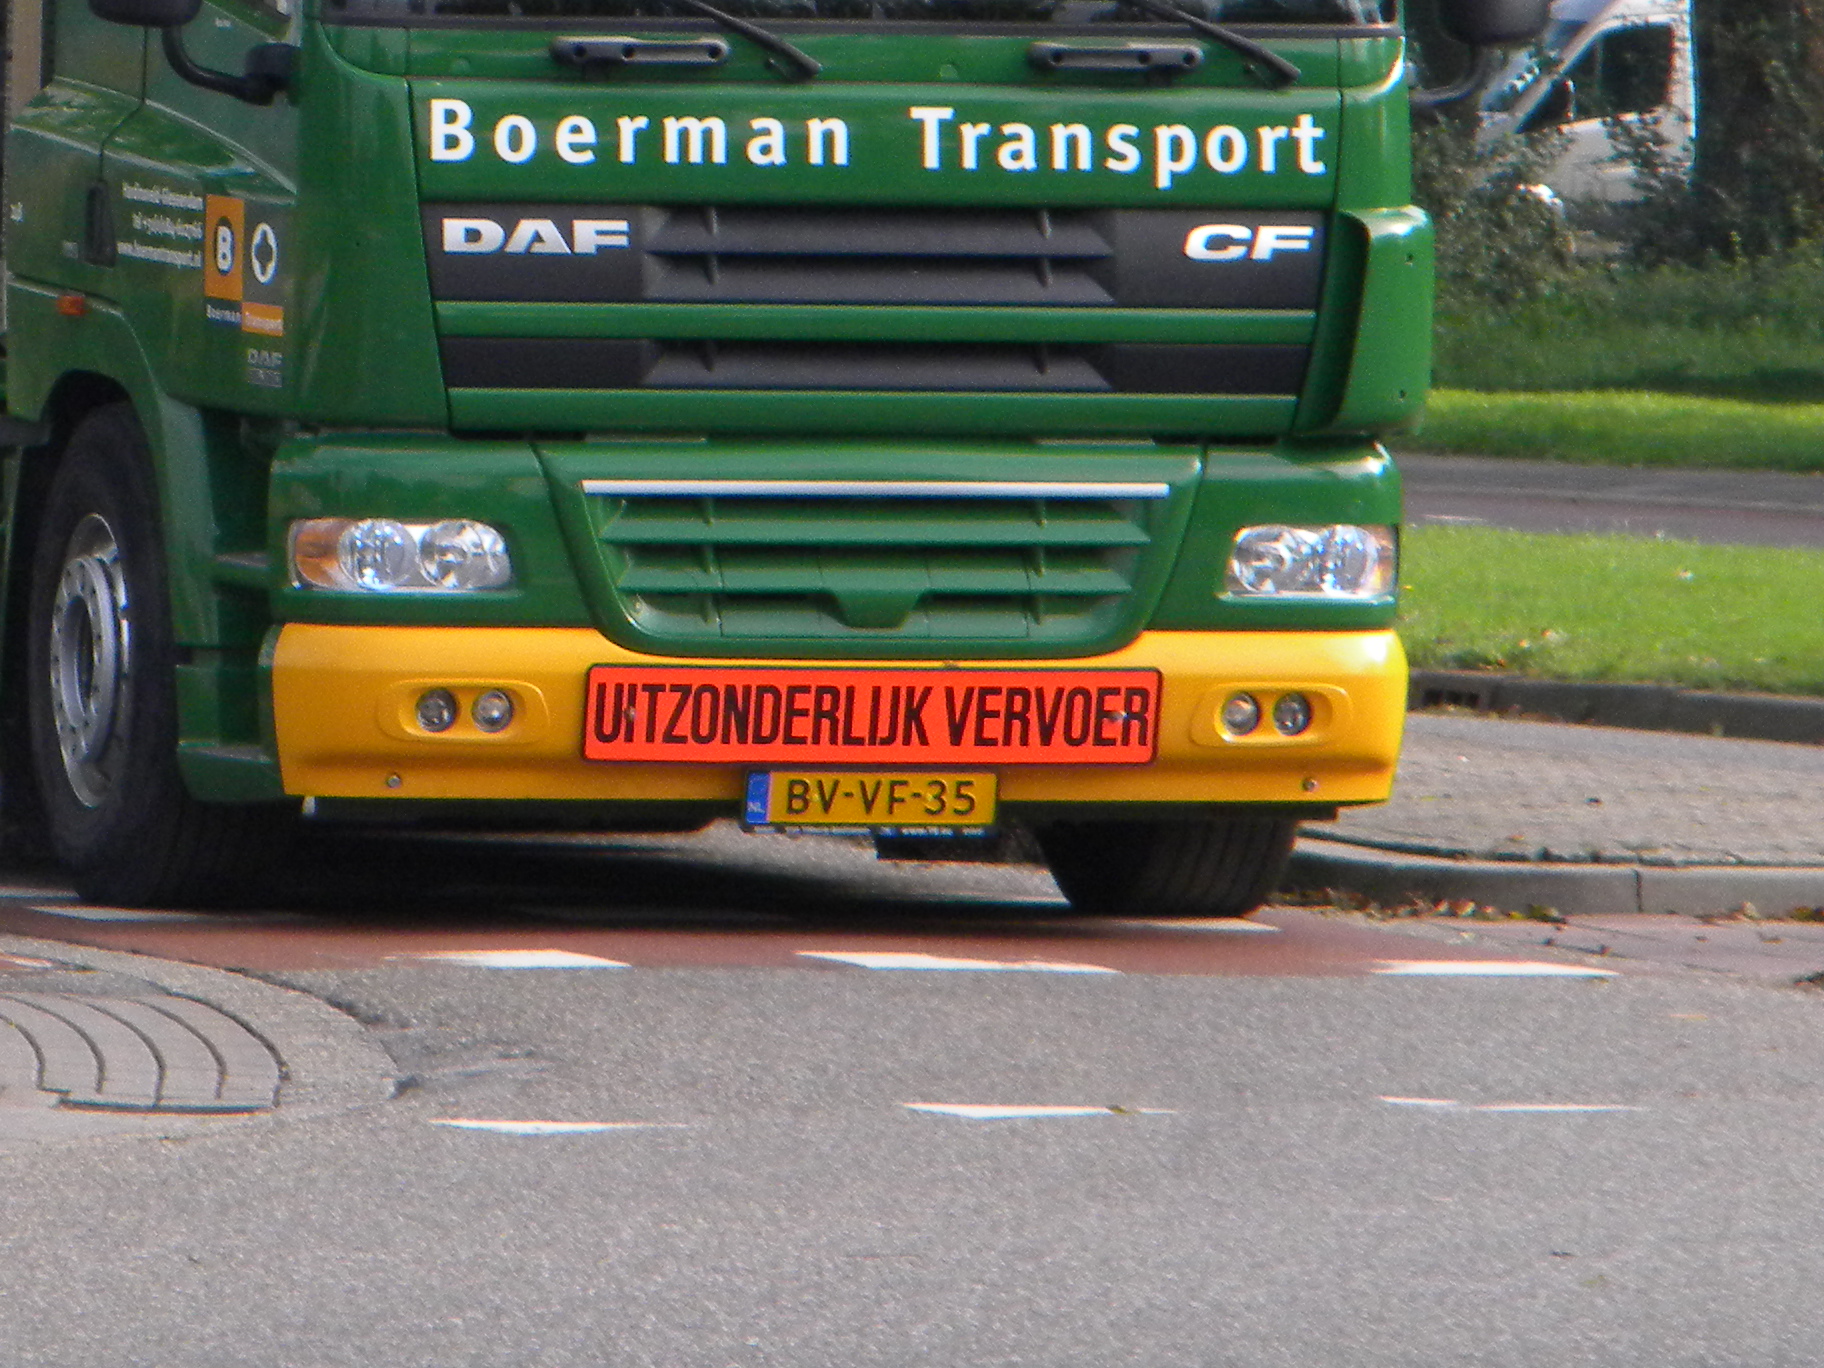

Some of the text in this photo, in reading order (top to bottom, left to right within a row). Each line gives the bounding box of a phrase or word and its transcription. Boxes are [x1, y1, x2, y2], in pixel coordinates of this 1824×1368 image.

[429, 98, 1327, 190] Boerman Transport
[441, 218, 630, 254] DAF
[1183, 223, 1316, 262] CF
[594, 682, 1149, 748] UITZONDERLIJK VERVOER
[786, 779, 976, 816] BV-VF-35
